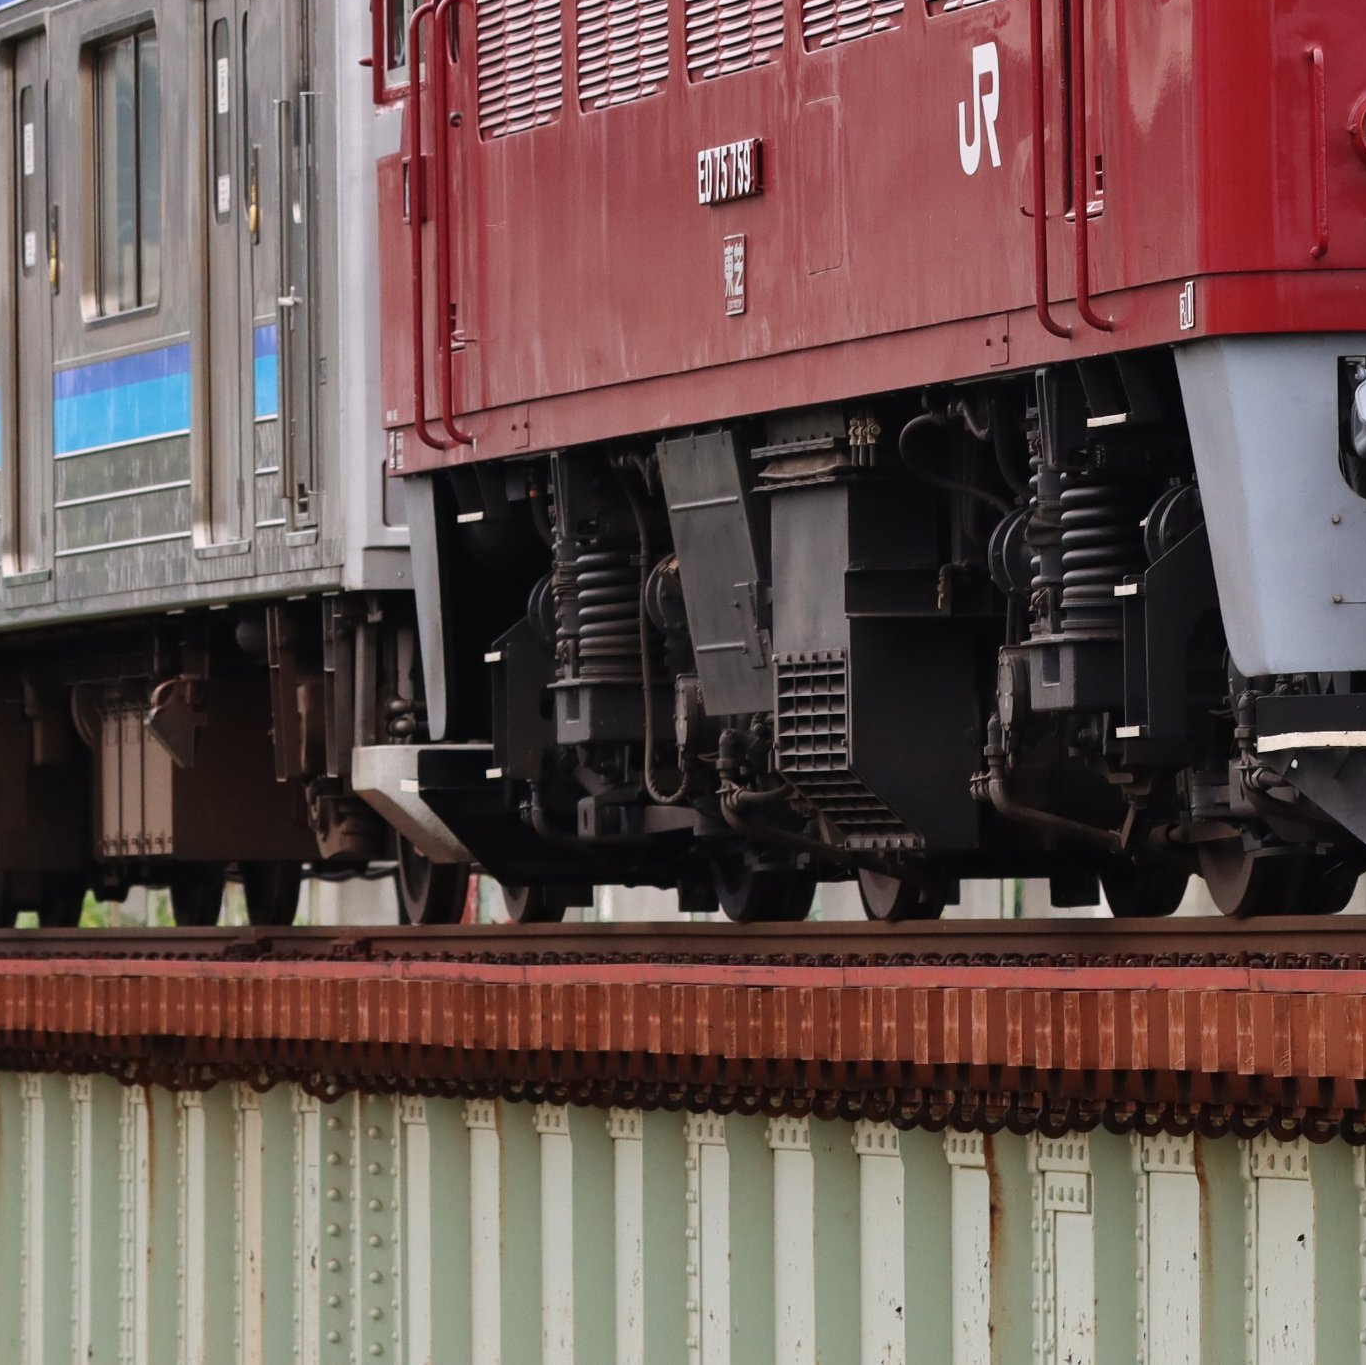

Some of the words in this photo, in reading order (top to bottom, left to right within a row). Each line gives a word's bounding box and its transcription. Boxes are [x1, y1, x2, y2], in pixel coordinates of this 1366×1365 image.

[958, 41, 1002, 176] JR
[697, 150, 713, 205] ED
[714, 146, 728, 201] 75
[729, 141, 752, 197] 759
[723, 242, 745, 298] 東芝
